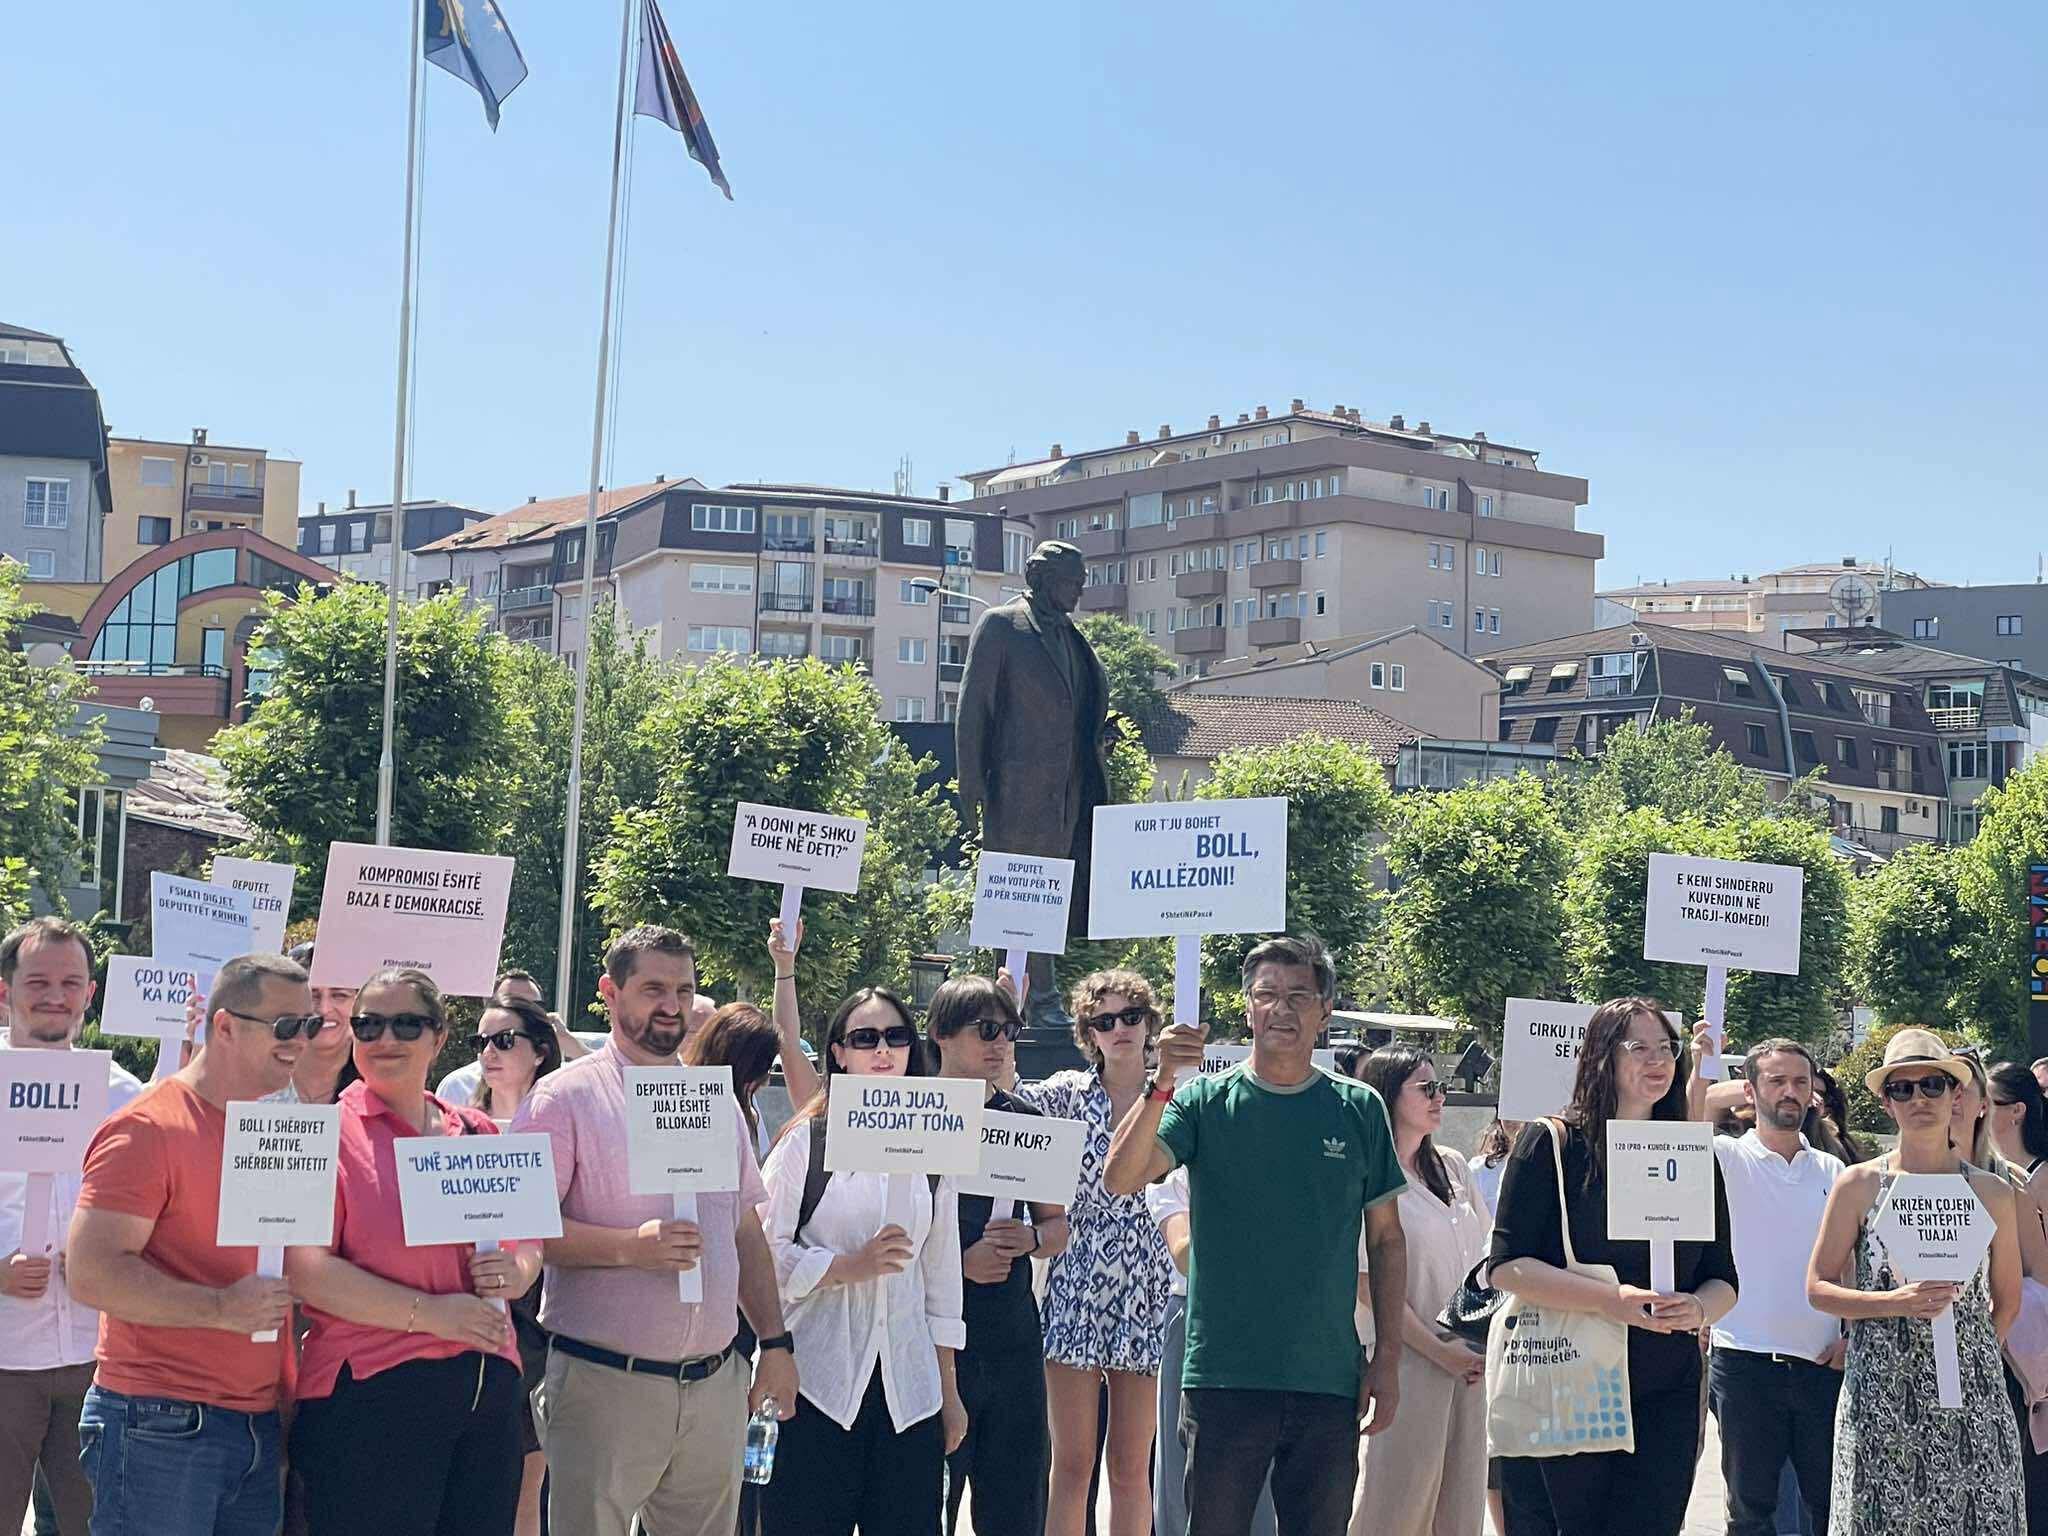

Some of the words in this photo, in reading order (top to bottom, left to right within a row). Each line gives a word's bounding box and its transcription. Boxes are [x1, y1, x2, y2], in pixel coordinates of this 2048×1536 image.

[761, 817, 793, 833] DONI
[798, 822, 817, 838] ME
[821, 826, 856, 843] SHKU
[1134, 818, 1157, 832] KUR
[1185, 816, 1221, 829] BOHET
[751, 834, 783, 850] EDHE
[786, 836, 804, 853] NË
[1196, 832, 1260, 859] BOLL,
[359, 866, 439, 887] KOMPROMISI
[443, 868, 482, 891] ËSHTË
[1008, 876, 1028, 887] VOTU
[1048, 879, 1061, 892] TY,
[1130, 862, 1235, 890] KALLËZONI!
[1678, 873, 1684, 885] E
[1687, 874, 1712, 888] KENI
[1715, 876, 1773, 894] SHNDËRRU
[347, 891, 379, 909] BAZA
[384, 894, 391, 908] E
[395, 895, 485, 917] DEMOKRACISË.
[983, 889, 993, 898] JO
[1012, 892, 1040, 903] SHEFIN
[1689, 891, 1743, 908] KUVENDIN
[1746, 895, 1761, 910] NË
[1681, 907, 1770, 927] TRAGJI-KOMEDI!
[134, 968, 163, 988] ÇDO
[169, 971, 193, 986] VO
[143, 988, 162, 1002] KA
[168, 990, 193, 1004] KO
[1529, 1022, 1567, 1039] CIRKU
[1571, 1026, 1574, 1039] I
[1555, 1041, 1570, 1058] SË
[10, 1082, 80, 1110] BOLL!
[636, 1080, 687, 1096] DEPUTETË
[700, 1083, 723, 1096] EMRI
[652, 1100, 677, 1113] JUAJ
[680, 1097, 711, 1113] ËSHTË
[863, 1089, 901, 1108] LOJA
[905, 1089, 948, 1113] JUAJ,
[240, 1118, 265, 1133] BOLL
[268, 1119, 272, 1133] I
[274, 1116, 325, 1134] SHËRBYET
[656, 1113, 711, 1130] BLLOKADË!
[848, 1111, 916, 1131] PASOJAT
[921, 1114, 964, 1132] TONA
[259, 1138, 303, 1153] PARTIVE,
[980, 1128, 1010, 1146] DERI
[1014, 1132, 1052, 1151] KUR?
[1614, 1143, 1626, 1151] 120
[234, 1153, 284, 1170] SHËRBENI
[287, 1157, 328, 1171] SHTETIT
[445, 1154, 473, 1171] JAM
[476, 1152, 542, 1170] DEPUTET/E
[1666, 1158, 1677, 1182] 0
[1892, 1195, 1932, 1211] KRIZËN
[1936, 1199, 1975, 1213] ÇOJENI
[1900, 1211, 1913, 1226] NË
[1917, 1211, 1971, 1226] SHTËPITË
[1918, 1229, 1958, 1241] TUAJA!
